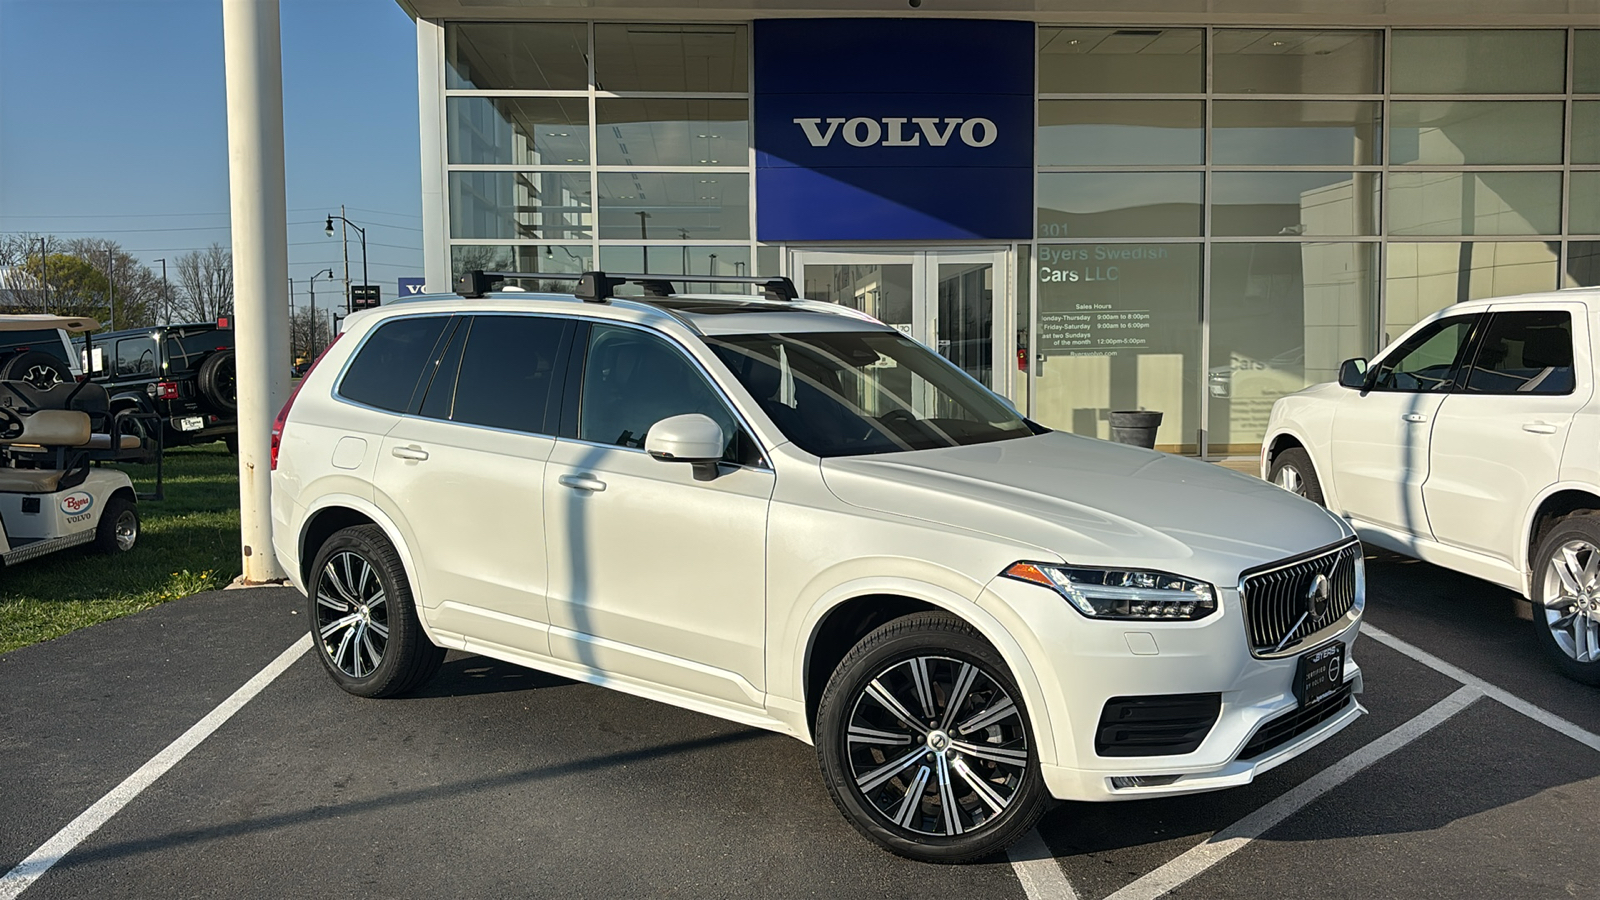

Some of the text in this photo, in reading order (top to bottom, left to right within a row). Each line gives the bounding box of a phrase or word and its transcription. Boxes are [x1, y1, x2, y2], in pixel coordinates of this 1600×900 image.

[793, 117, 998, 148] VOLVO
[1040, 223, 1068, 237] 301
[1039, 245, 1168, 265] Byers Swedish
[1040, 266, 1119, 282] Cars LLC
[1043, 323, 1091, 331] Friday-Saturday
[1064, 332, 1091, 340] Sundays
[63, 497, 89, 510] Byers
[66, 513, 91, 524] VOLVO
